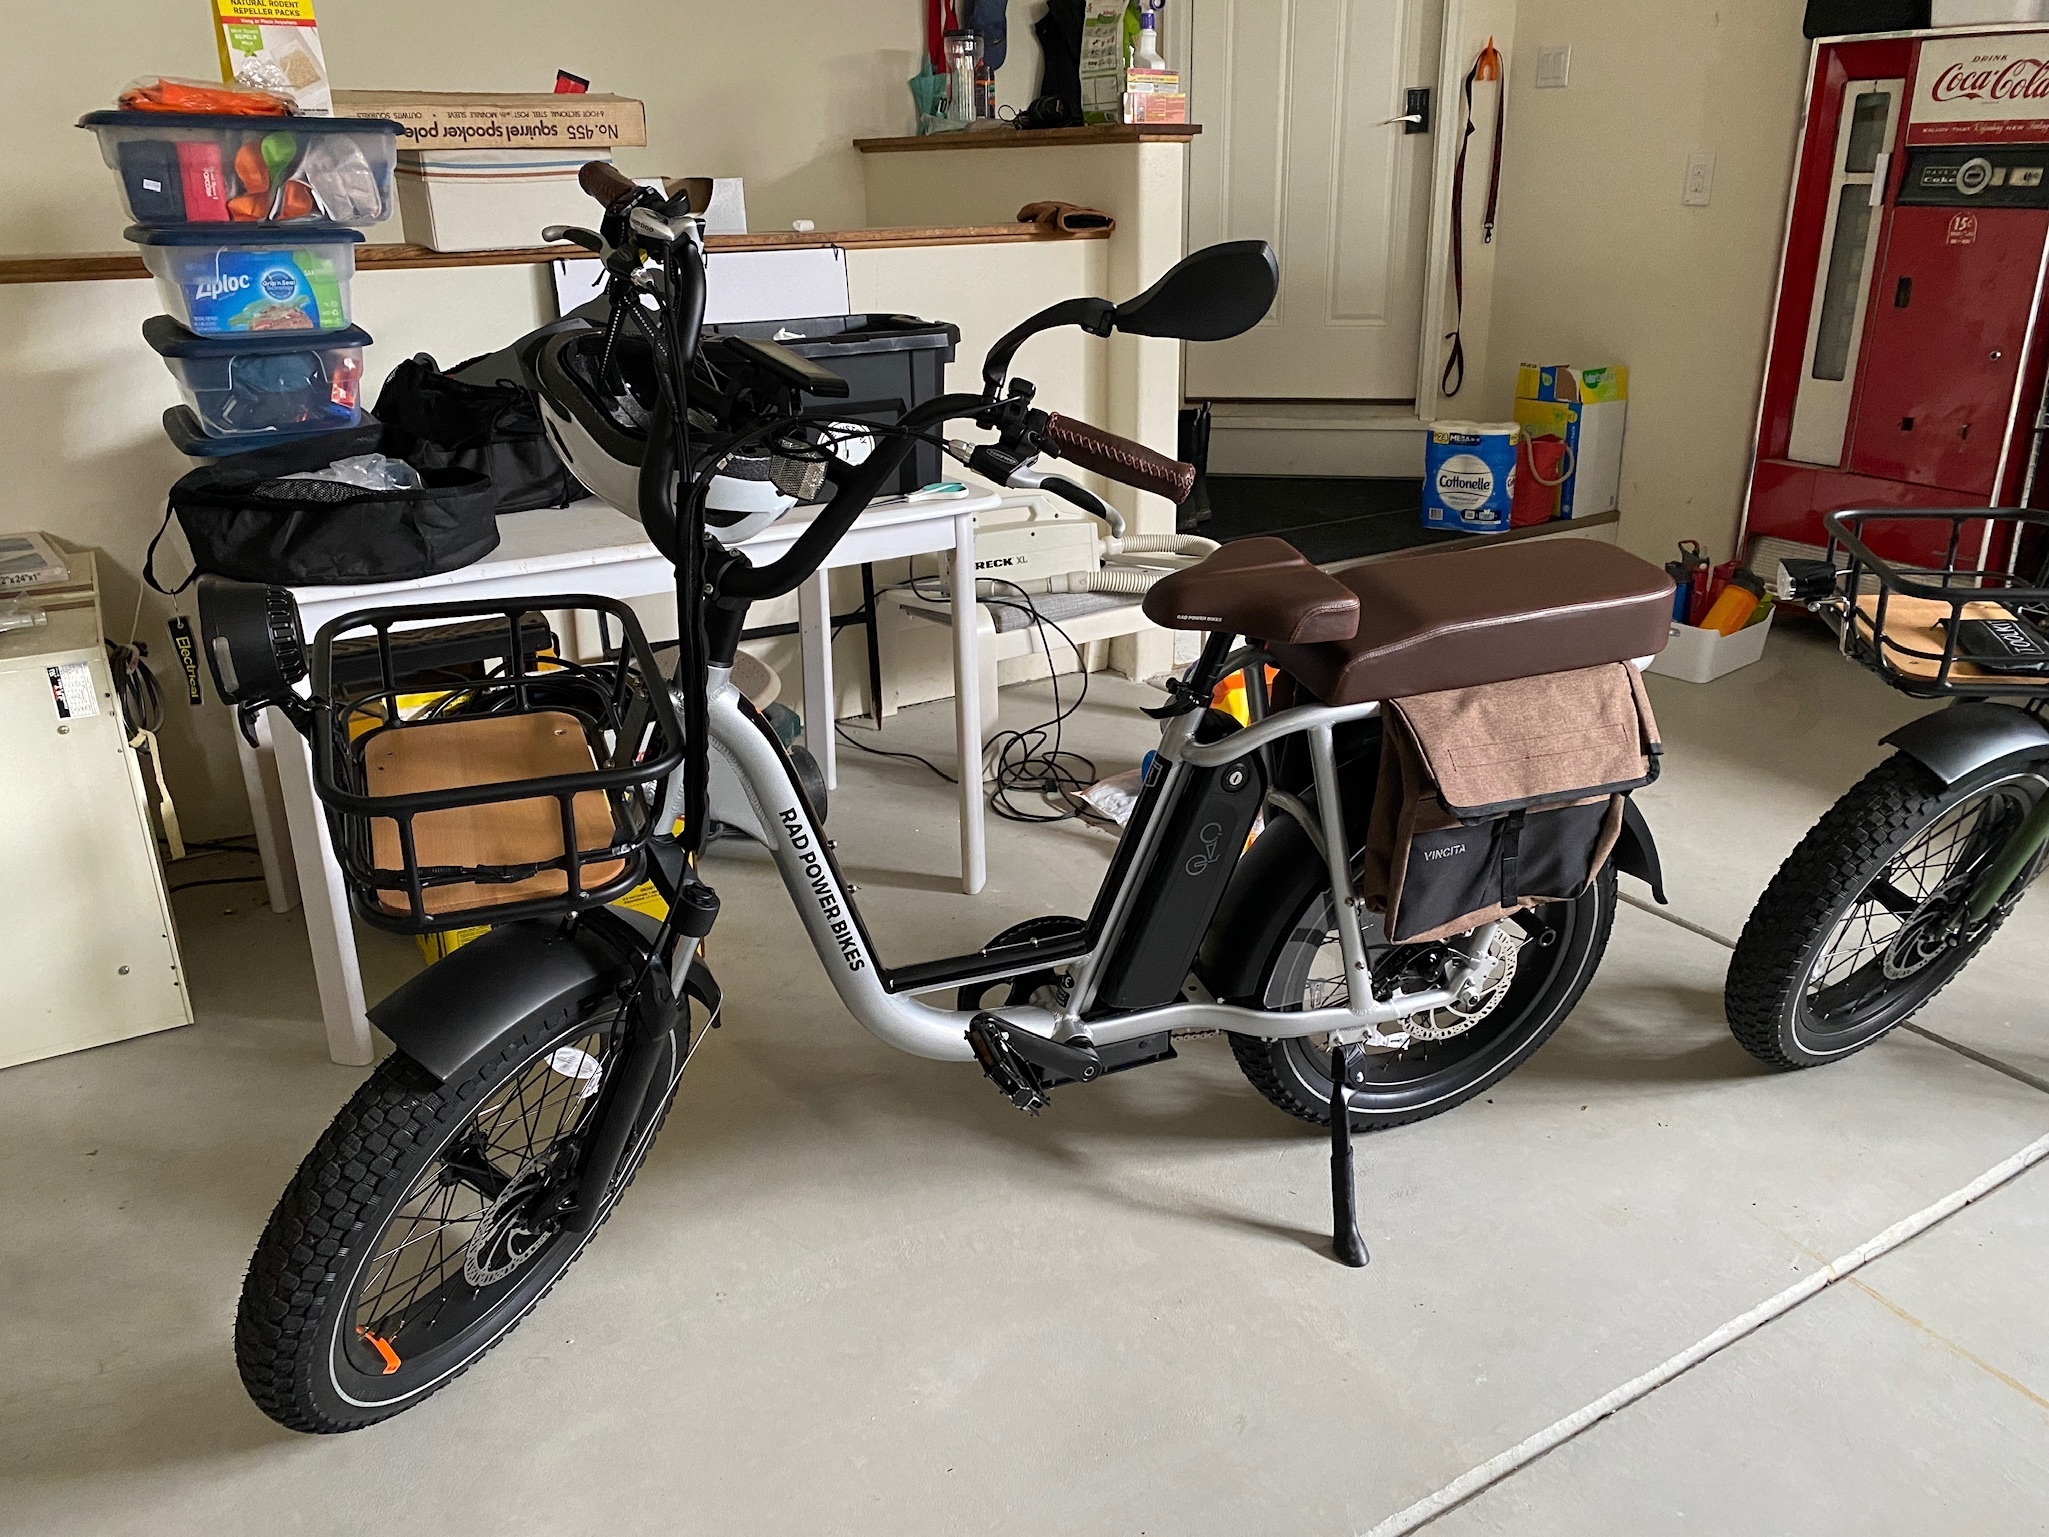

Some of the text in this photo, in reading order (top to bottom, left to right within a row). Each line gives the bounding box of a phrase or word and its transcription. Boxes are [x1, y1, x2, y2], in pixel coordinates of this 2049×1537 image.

[268, 0, 299, 8] RODENT
[233, 7, 300, 17] REPELLER PACKS
[1972, 54, 2009, 63] DRINK
[446, 111, 467, 119] SLEEVE
[469, 111, 498, 119] MOVABLE
[513, 110, 530, 118] POST
[532, 110, 548, 118] STEEL
[551, 110, 581, 118] SECTIONAL
[405, 120, 439, 143] pole
[443, 120, 504, 143] spooker
[506, 120, 558, 142] squirrel
[195, 273, 250, 300] Ziploc
[1438, 433, 1449, 441] 24
[1450, 434, 1471, 442] MEGA
[1440, 475, 1490, 490] Cottonelle
[975, 556, 1028, 570] RECK XL
[1987, 620, 2036, 653] TOOLKIT
[176, 636, 199, 698] Electrical
[1424, 844, 1466, 861] VINCITA
[778, 807, 865, 972] RAD POWER BIKES
